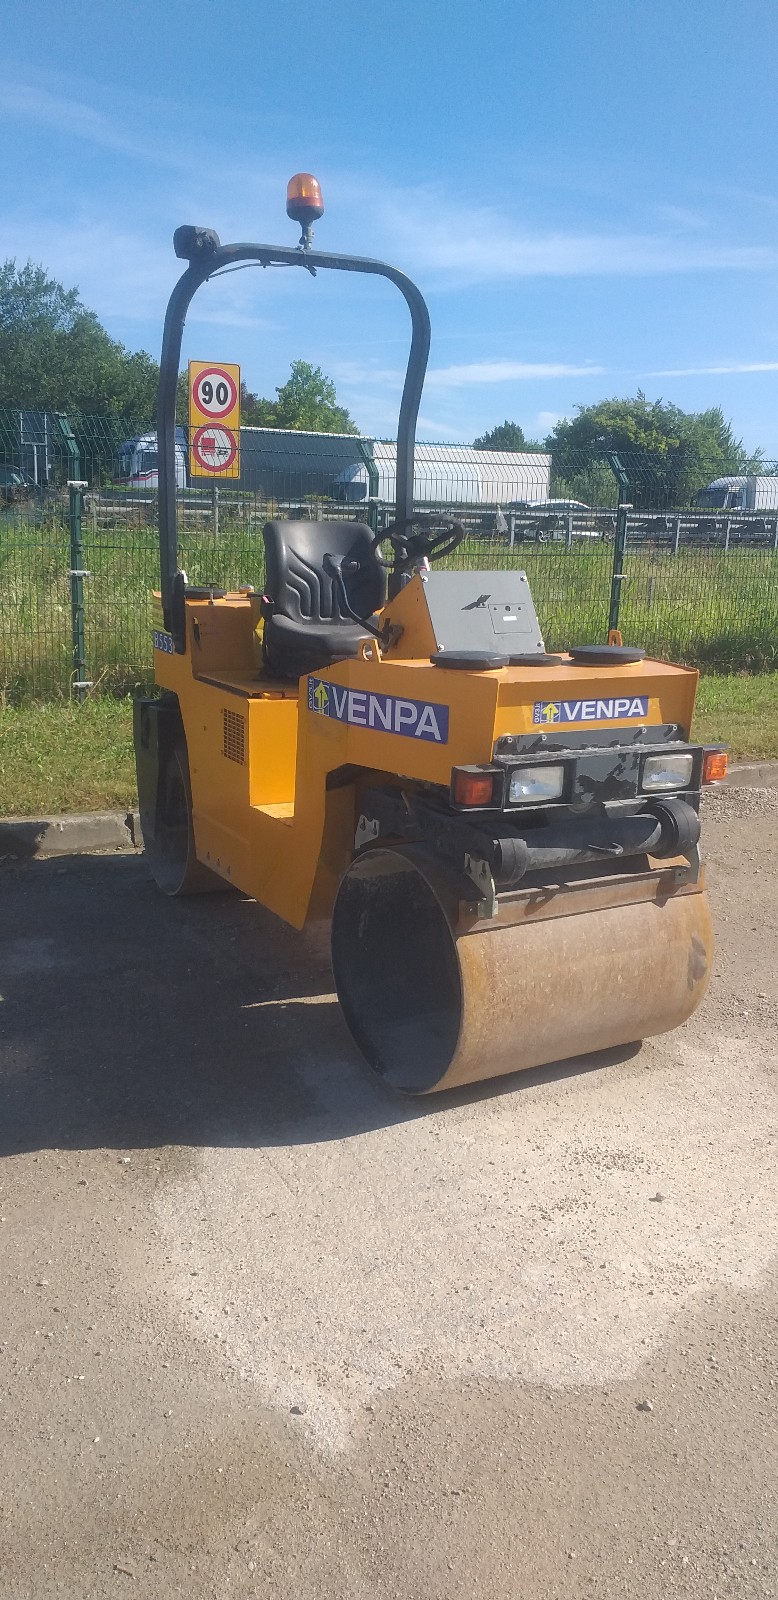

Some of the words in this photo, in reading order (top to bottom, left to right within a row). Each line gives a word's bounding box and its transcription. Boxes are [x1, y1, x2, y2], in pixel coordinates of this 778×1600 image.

[201, 380, 229, 406] 90
[332, 686, 442, 741] VENPA
[563, 697, 645, 721] VENPA
